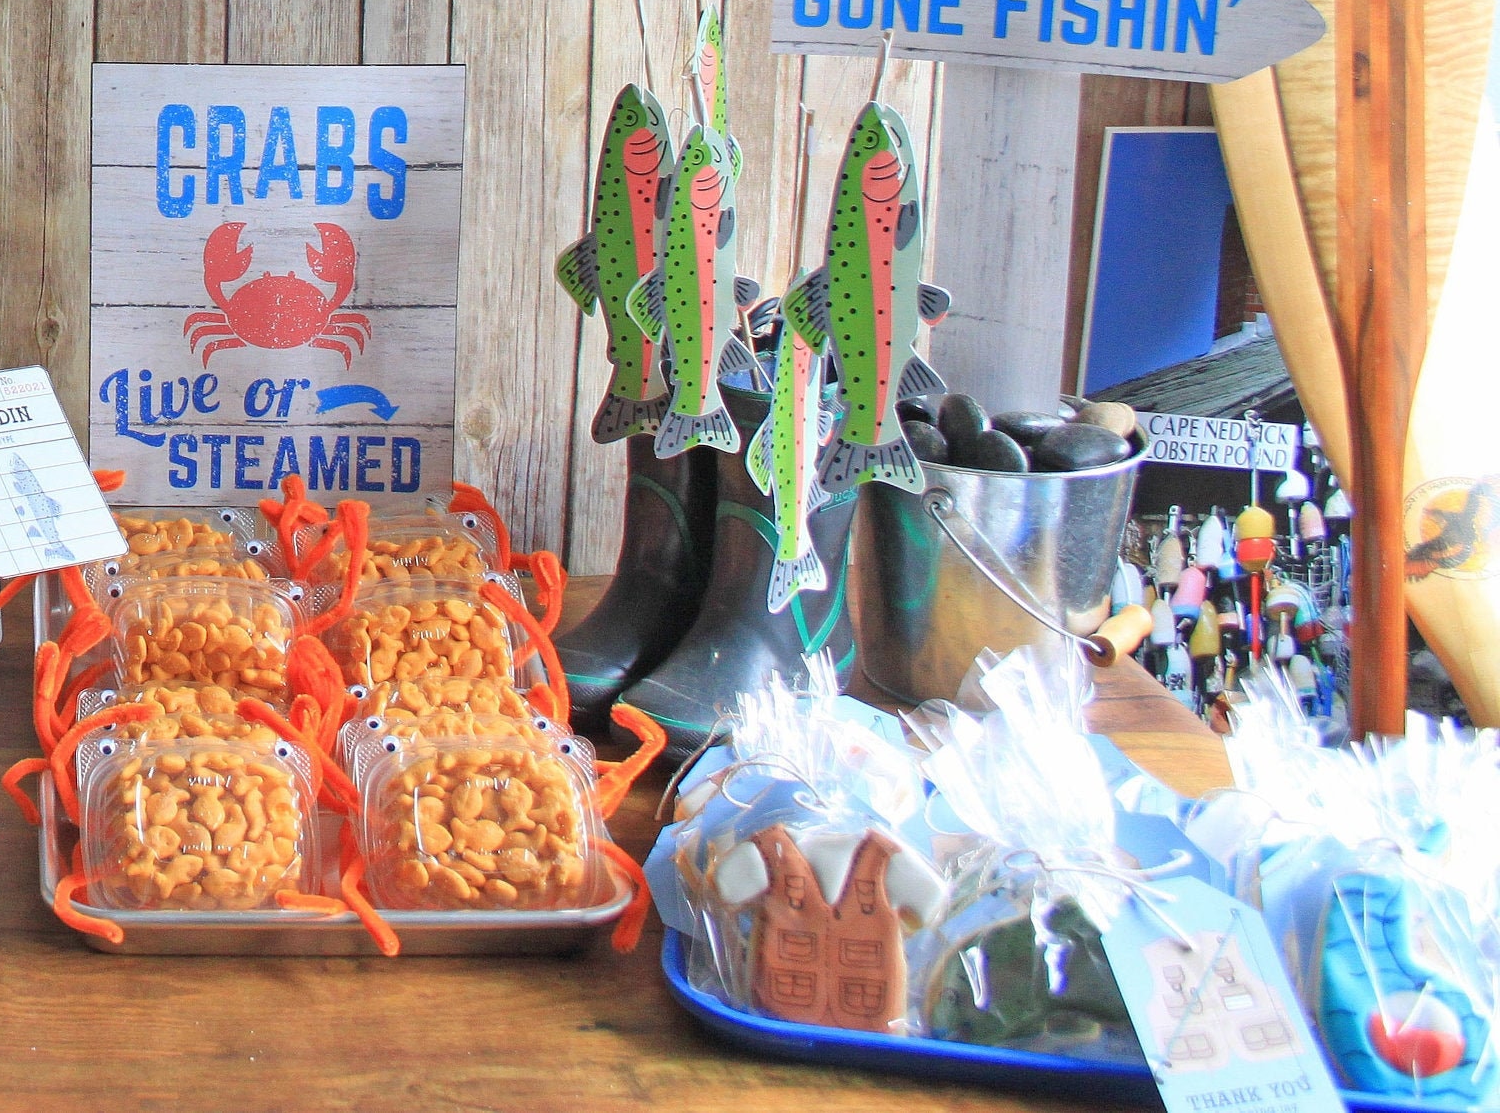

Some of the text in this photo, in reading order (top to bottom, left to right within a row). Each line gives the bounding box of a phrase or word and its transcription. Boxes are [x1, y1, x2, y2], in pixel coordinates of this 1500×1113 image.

[156, 104, 409, 220] CRABS
[99, 368, 310, 448] Live or
[1149, 415, 1288, 445] CAPE NEDICK
[168, 434, 421, 493] STEAMED
[1147, 439, 1218, 464] OBSTER
[1186, 1074, 1312, 1111] THANK YOU
